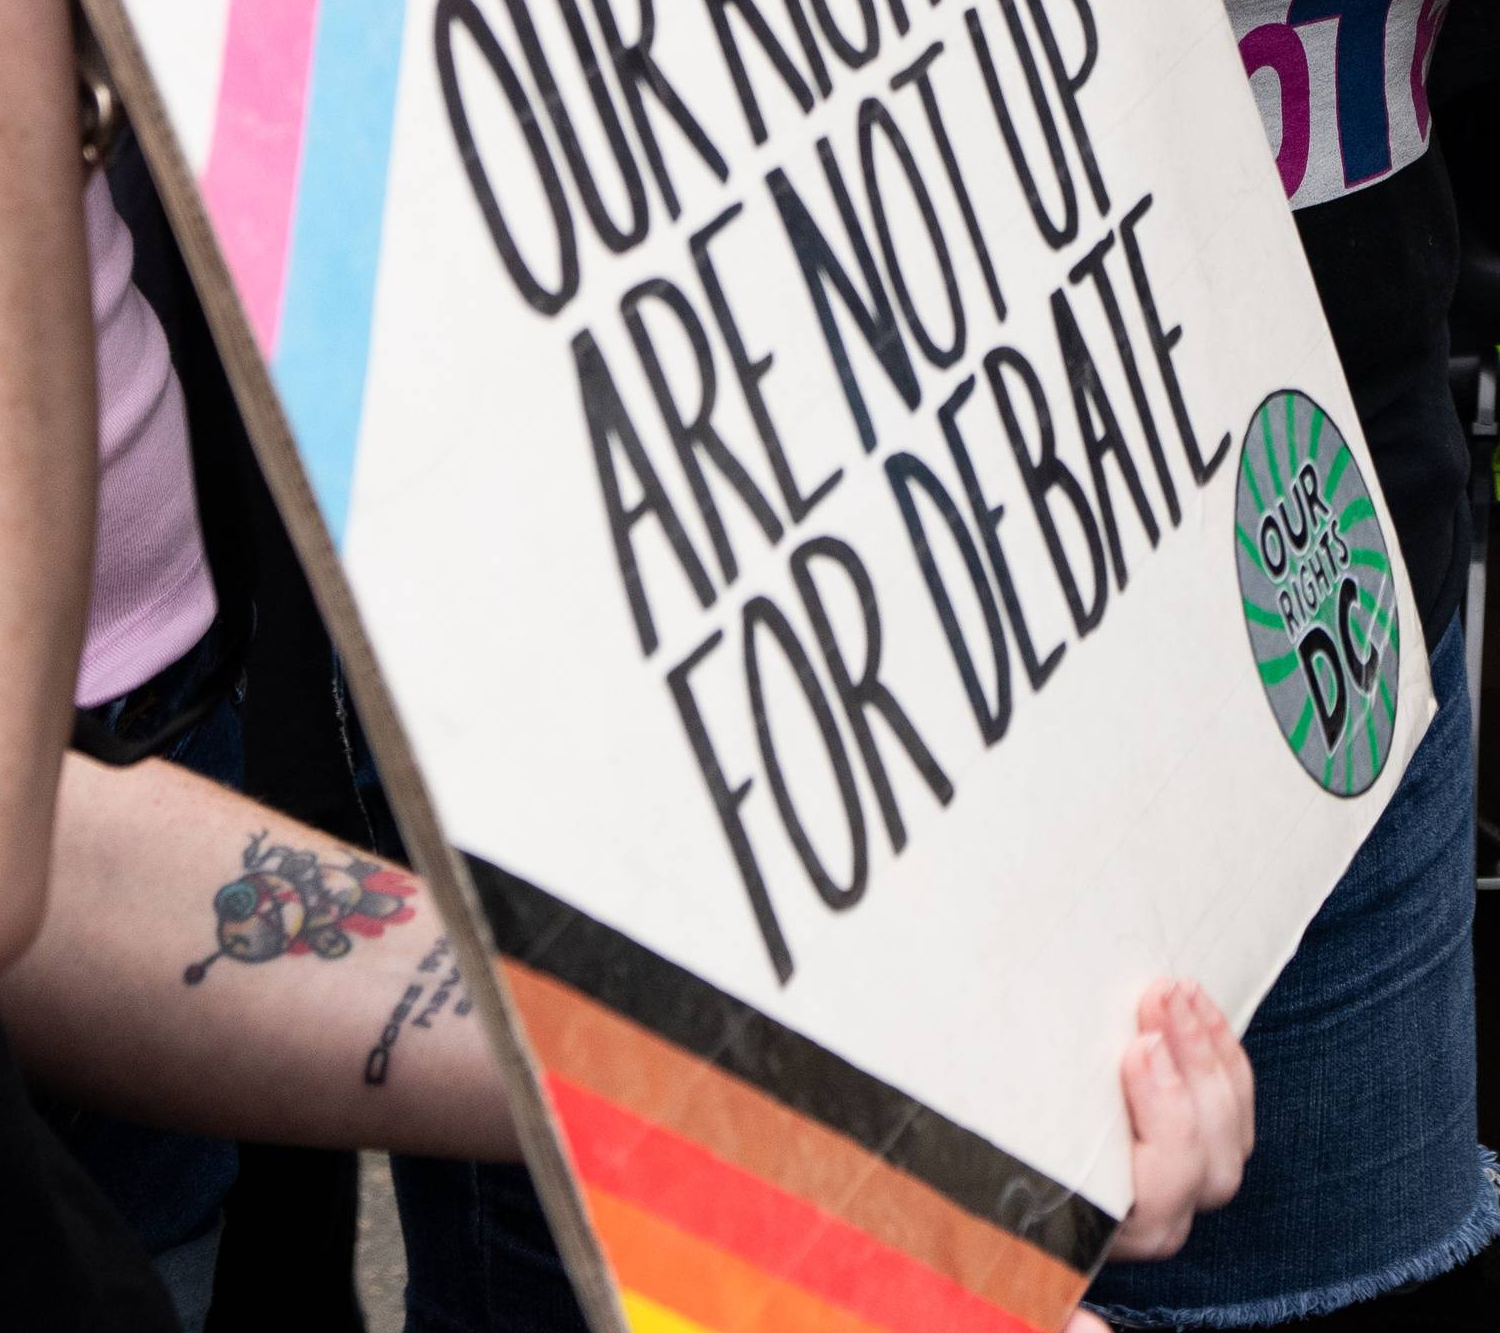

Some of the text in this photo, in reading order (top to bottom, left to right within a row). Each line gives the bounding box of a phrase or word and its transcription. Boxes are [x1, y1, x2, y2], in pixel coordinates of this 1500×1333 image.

[570, 201, 844, 657] ARE
[766, 39, 1011, 454] NOT
[664, 192, 1234, 989] FOR DEBATE
[1257, 463, 1331, 581] OUR
[1276, 519, 1350, 636] RIGHTS
[1298, 577, 1380, 758] DC
